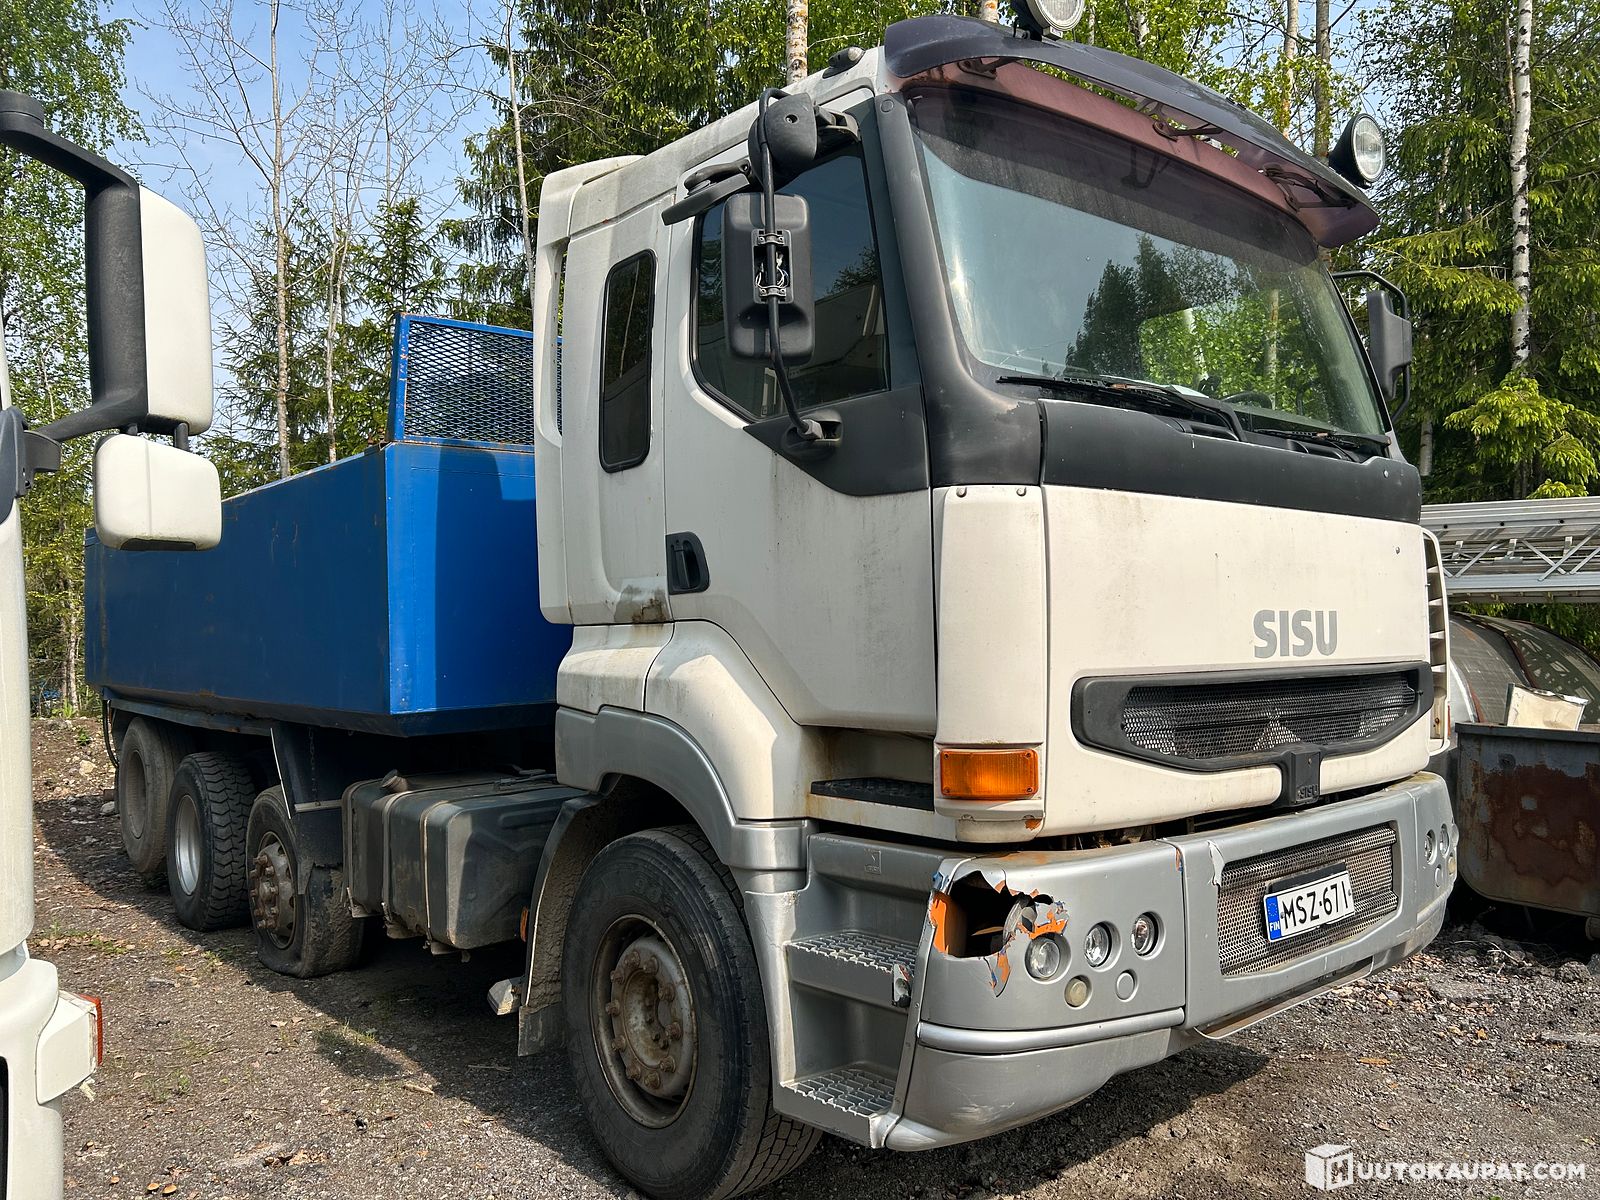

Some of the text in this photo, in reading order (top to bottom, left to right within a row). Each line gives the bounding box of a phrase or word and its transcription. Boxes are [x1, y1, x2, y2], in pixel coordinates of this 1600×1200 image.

[1253, 609, 1337, 658] SISU
[1299, 785, 1318, 799] SISU
[1282, 881, 1348, 929] MSZ-671
[1269, 920, 1281, 932] FIN
